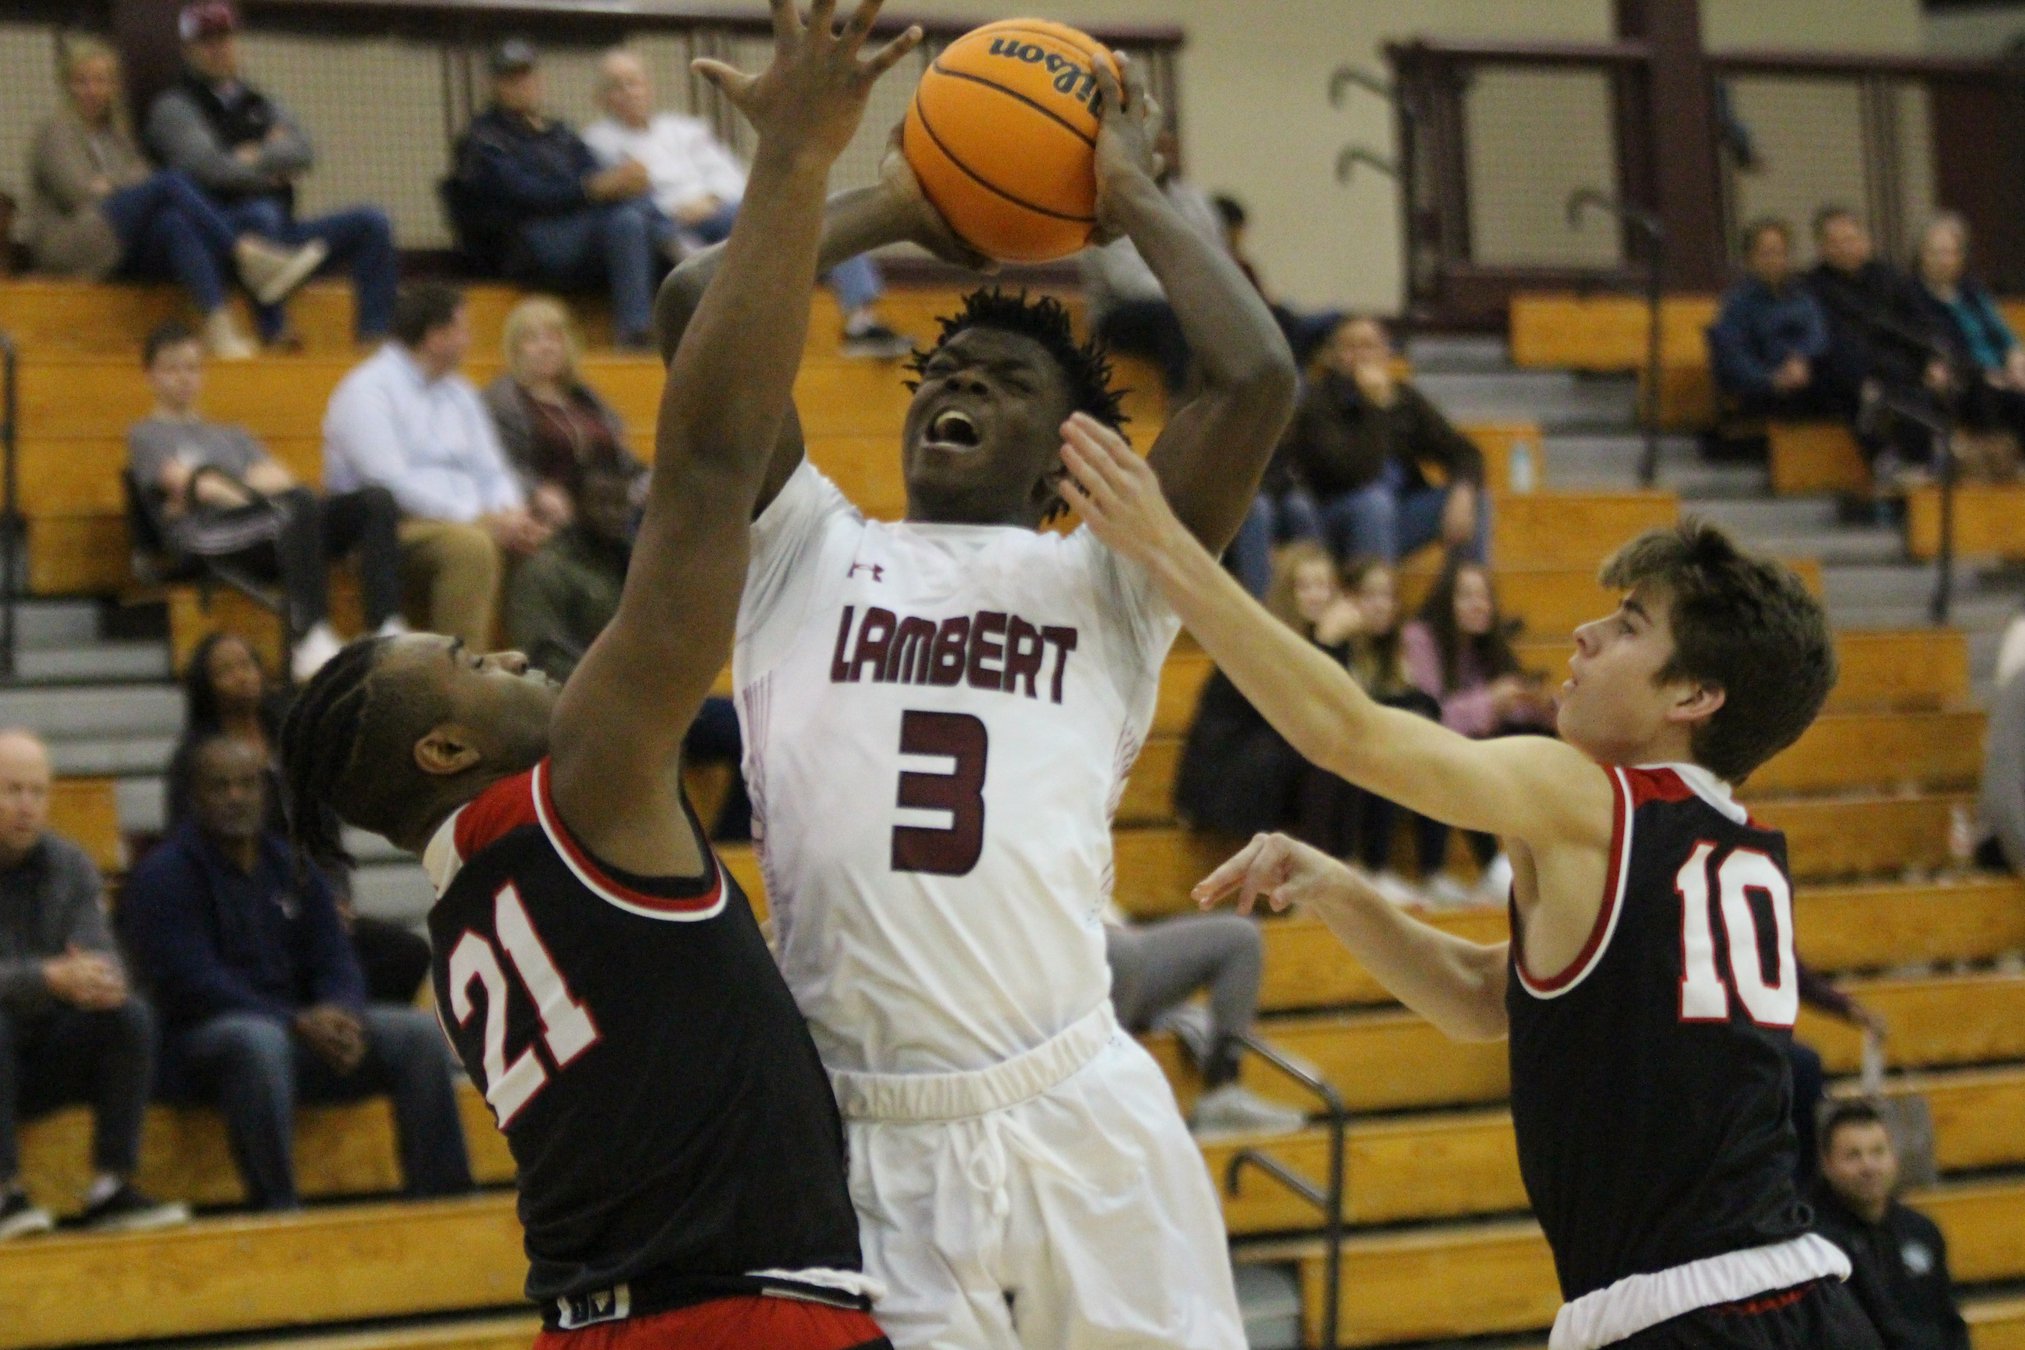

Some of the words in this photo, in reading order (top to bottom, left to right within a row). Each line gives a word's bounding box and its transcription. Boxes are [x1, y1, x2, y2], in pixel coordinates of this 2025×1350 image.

[989, 38, 1103, 117] ilson
[830, 605, 1078, 704] LAMBERT
[890, 709, 988, 877] 3
[449, 881, 600, 1130] 21
[1675, 841, 1799, 1027] 10
